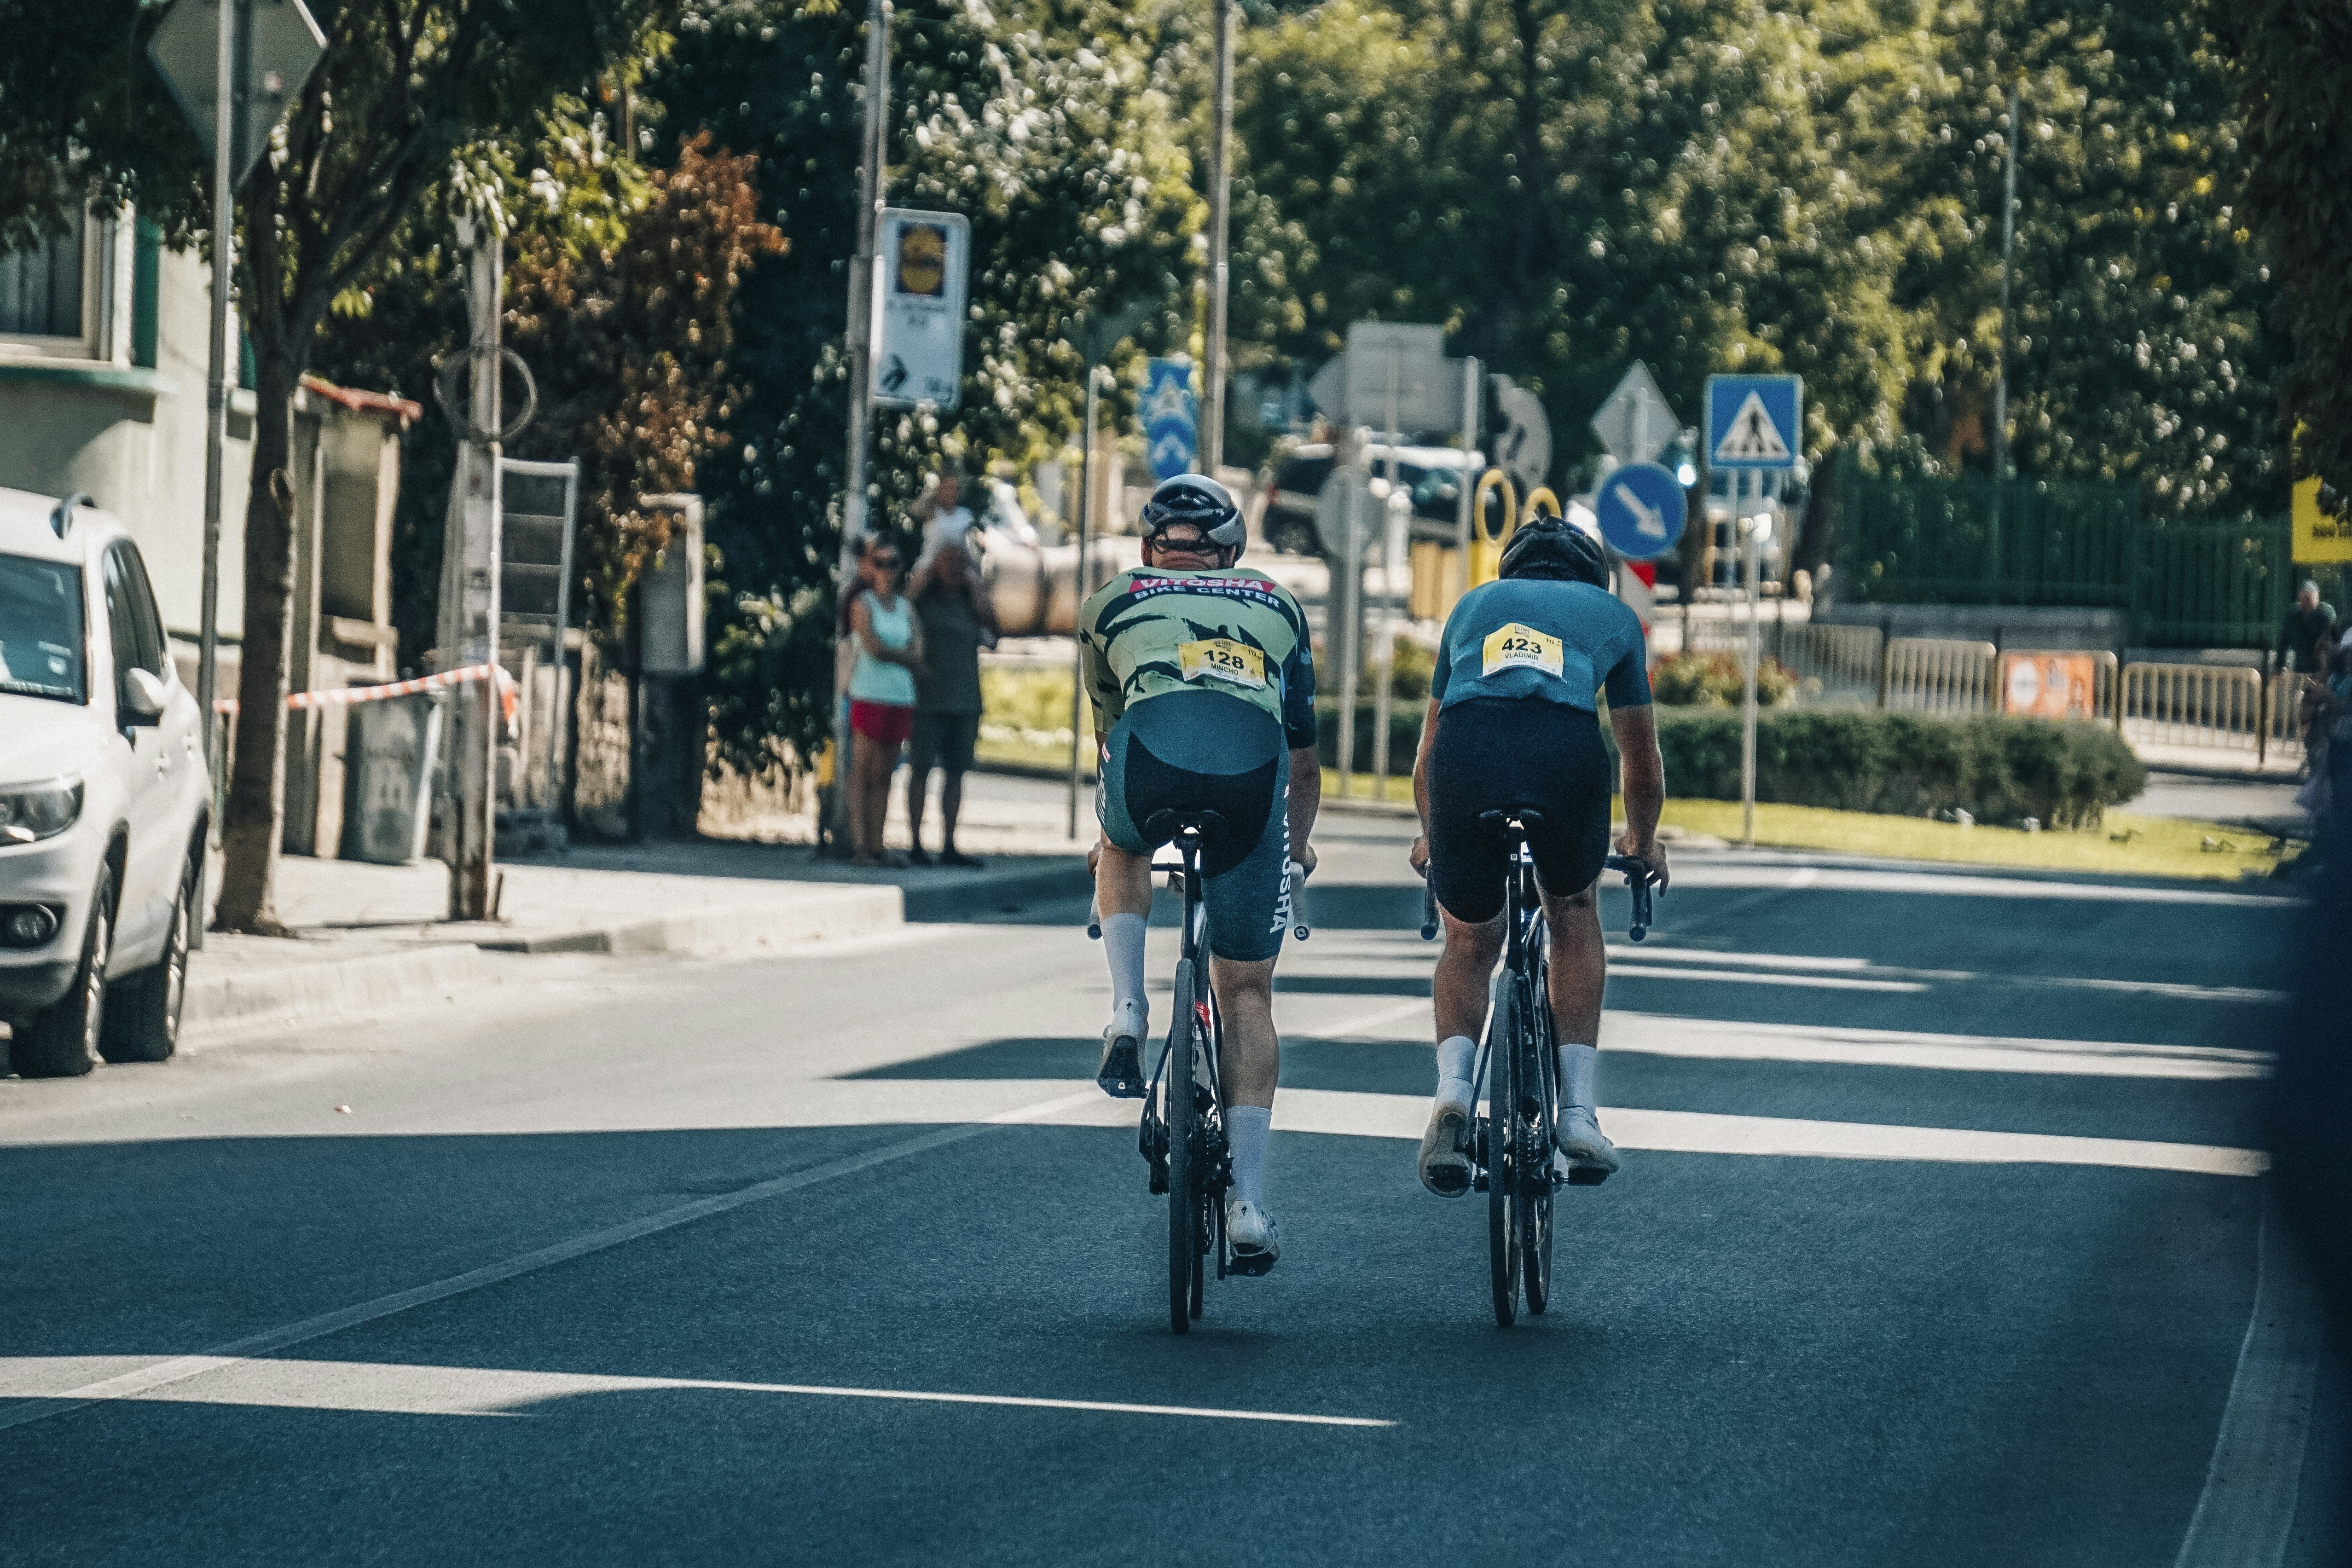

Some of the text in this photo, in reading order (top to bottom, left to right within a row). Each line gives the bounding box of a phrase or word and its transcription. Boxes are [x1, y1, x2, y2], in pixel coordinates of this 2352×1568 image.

[1140, 579, 1264, 591] VITOSHA
[1134, 586, 1280, 608] BIKE CENTER
[1501, 637, 1542, 654] 423
[1204, 650, 1245, 669] 128
[1505, 652, 1539, 661] VLADIMIR
[1211, 662, 1239, 675] MINCHO
